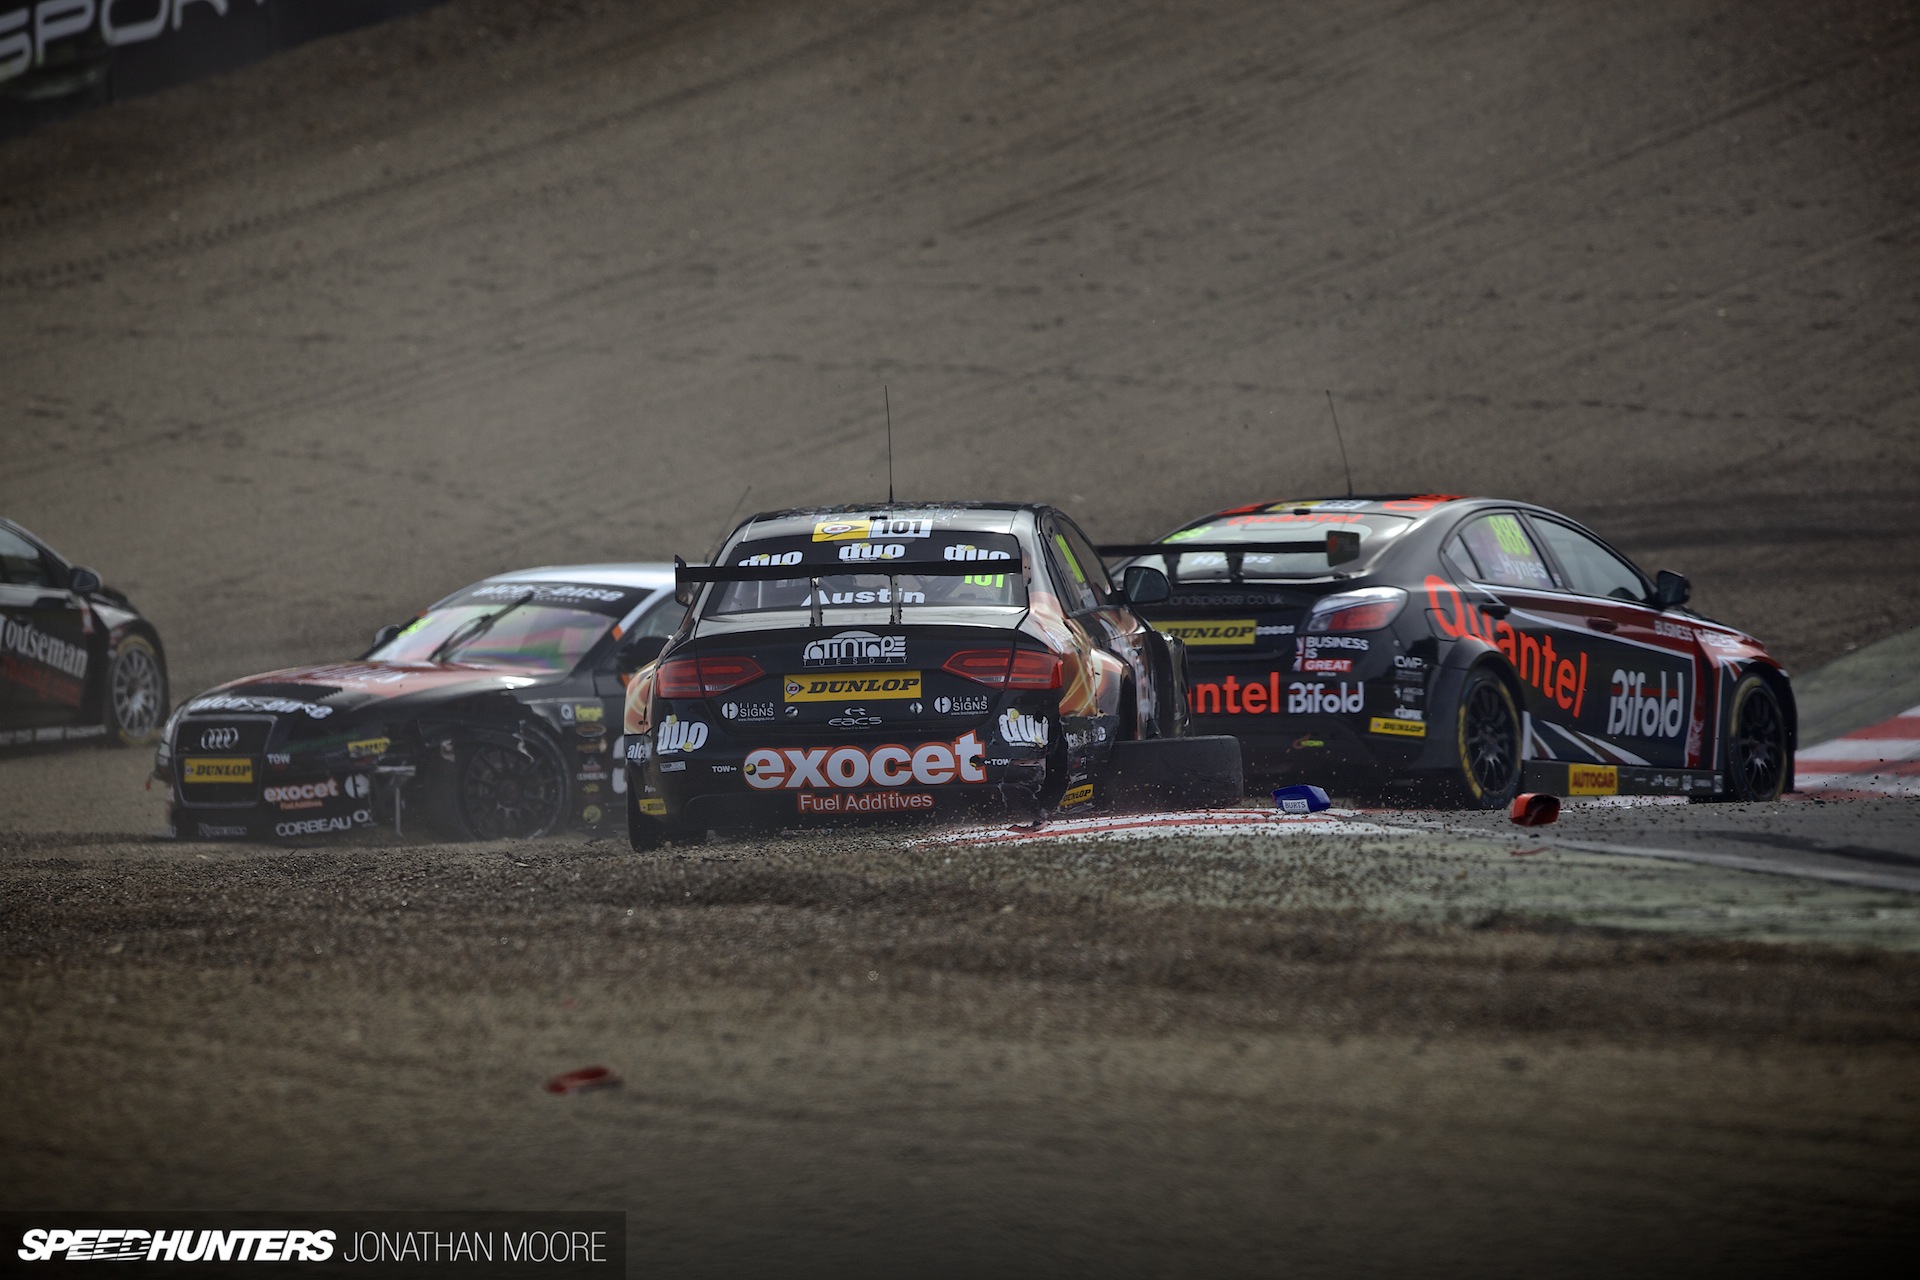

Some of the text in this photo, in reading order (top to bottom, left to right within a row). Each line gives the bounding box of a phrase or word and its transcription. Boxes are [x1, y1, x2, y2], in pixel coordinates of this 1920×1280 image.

[879, 519, 923, 535] 101
[1488, 515, 1531, 556] 888
[838, 541, 905, 558] duo
[1499, 558, 1546, 579] Hynes
[801, 588, 926, 606] Austin
[1306, 637, 1369, 650] BUSINESS
[1424, 575, 1587, 718] Quantel
[1305, 648, 1318, 658] IS
[803, 657, 908, 667] TUESDAY
[1305, 660, 1351, 671] GREAT
[807, 679, 920, 694] DUNLOP
[952, 695, 988, 703] finch
[953, 701, 988, 711] SIGNS
[1288, 682, 1364, 714] Bifold
[1607, 669, 1684, 738] Bifold
[740, 708, 774, 717] SIGNS
[657, 714, 709, 753] duo
[267, 754, 290, 765] TOW
[745, 734, 986, 789] exocet
[197, 765, 251, 776] DUNLOP
[1572, 770, 1616, 788] AUTOCAR
[264, 778, 338, 802] exocet
[800, 791, 933, 811] Fuel Additives
[1284, 801, 1306, 809] BURTS
[275, 816, 352, 837] CORBEAU
